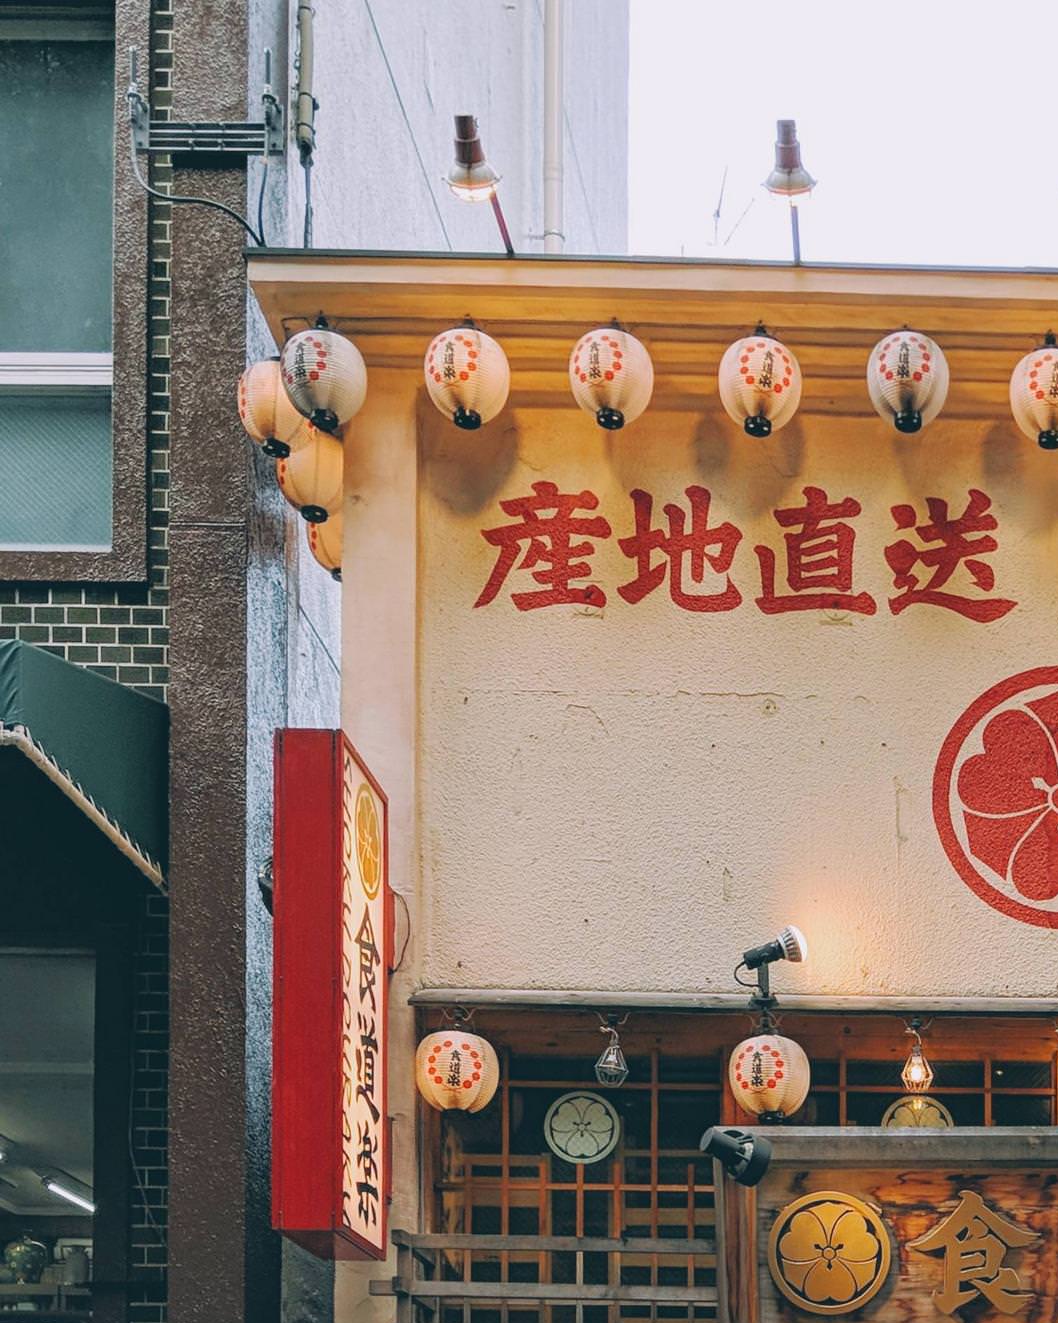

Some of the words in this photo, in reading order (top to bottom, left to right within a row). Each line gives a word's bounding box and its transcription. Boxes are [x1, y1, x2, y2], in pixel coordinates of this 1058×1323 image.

[473, 480, 1018, 625] 産地直送
[353, 902, 382, 1230] 食道楽
